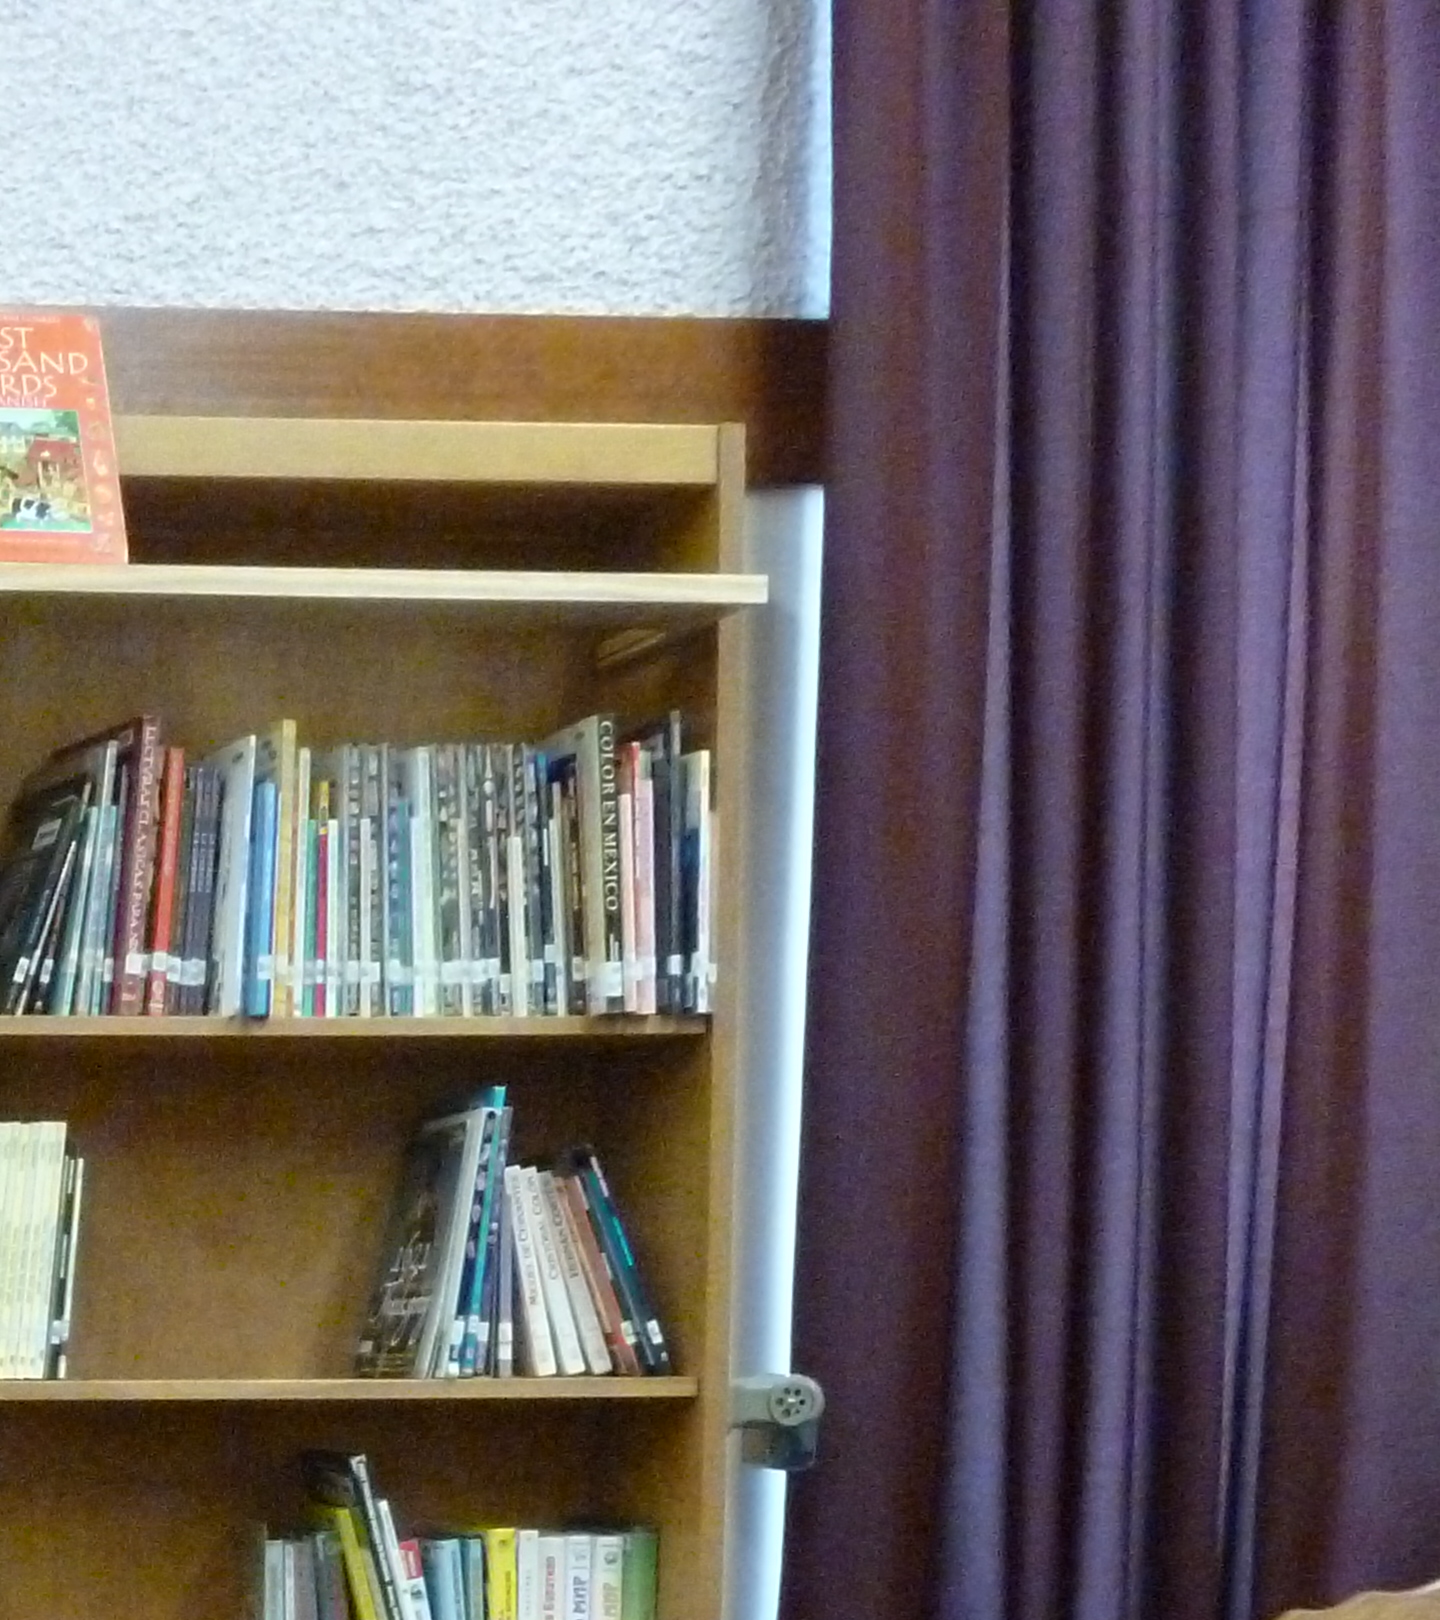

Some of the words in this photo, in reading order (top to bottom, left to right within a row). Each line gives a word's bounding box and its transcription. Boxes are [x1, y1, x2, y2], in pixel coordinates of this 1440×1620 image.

[600, 719, 616, 795] COLOR
[604, 799, 617, 816] EN
[602, 820, 618, 912] MEXICO
